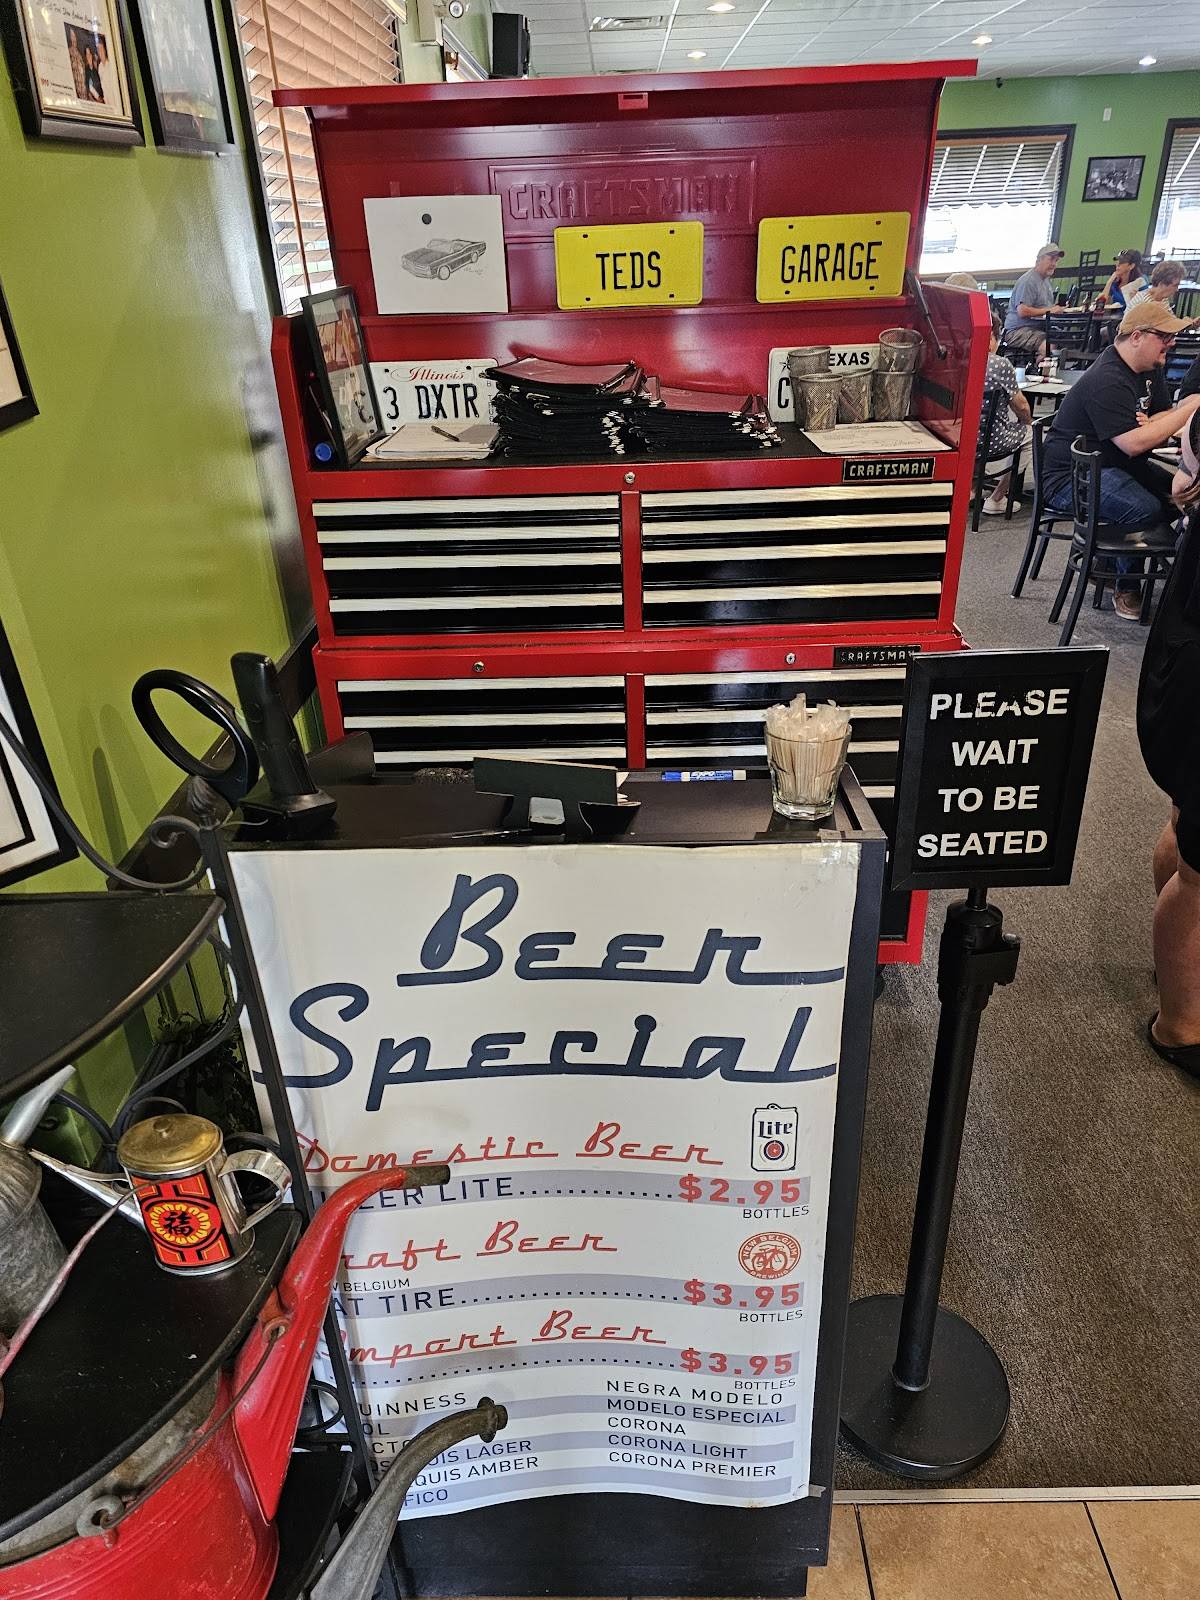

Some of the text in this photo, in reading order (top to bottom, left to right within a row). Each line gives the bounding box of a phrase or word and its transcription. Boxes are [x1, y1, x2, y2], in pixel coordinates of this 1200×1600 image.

[508, 173, 741, 220] CRAFTSMAN
[595, 250, 662, 291] TEDS
[781, 240, 883, 284] GARAGE
[829, 351, 870, 367] EXAS
[397, 366, 465, 382] Illinois
[415, 383, 480, 419] DXTR
[849, 462, 929, 478] CRAFTSMAN
[930, 688, 1070, 720] PLEASE
[952, 738, 1039, 767] WAIT
[938, 785, 1040, 812] TO BE
[917, 830, 1048, 858] SEATED
[397, 873, 845, 987] Beer
[252, 982, 837, 1112] Special
[757, 1120, 793, 1139] Lite
[575, 1121, 724, 1166] Beer
[439, 1177, 513, 1202] LITE
[678, 1173, 801, 1205] $2.95
[743, 1205, 809, 1219] BOTTLES
[341, 1220, 617, 1271] raft Beer
[743, 1234, 798, 1257] NEW BELGIUM
[334, 1278, 800, 1316] AT TIRE $3.95
[344, 1278, 410, 1293] BELGIUM
[739, 1309, 803, 1323] BOTTLES
[344, 1309, 666, 1368] mport Beer
[680, 1347, 793, 1376] $3.95
[606, 1379, 783, 1405] NEGRA MODELO
[734, 1378, 796, 1391] BOTTLES
[359, 1392, 467, 1416] UINNESS
[607, 1398, 786, 1424] MODELO ESPECIAL
[362, 1422, 390, 1436] OL
[607, 1416, 686, 1435] CORONA
[466, 1440, 532, 1460] LAGER
[608, 1434, 748, 1460] CORONA LIGHT
[412, 1456, 539, 1488] QUIS AMBER
[608, 1451, 776, 1477] CORONA PREMIER
